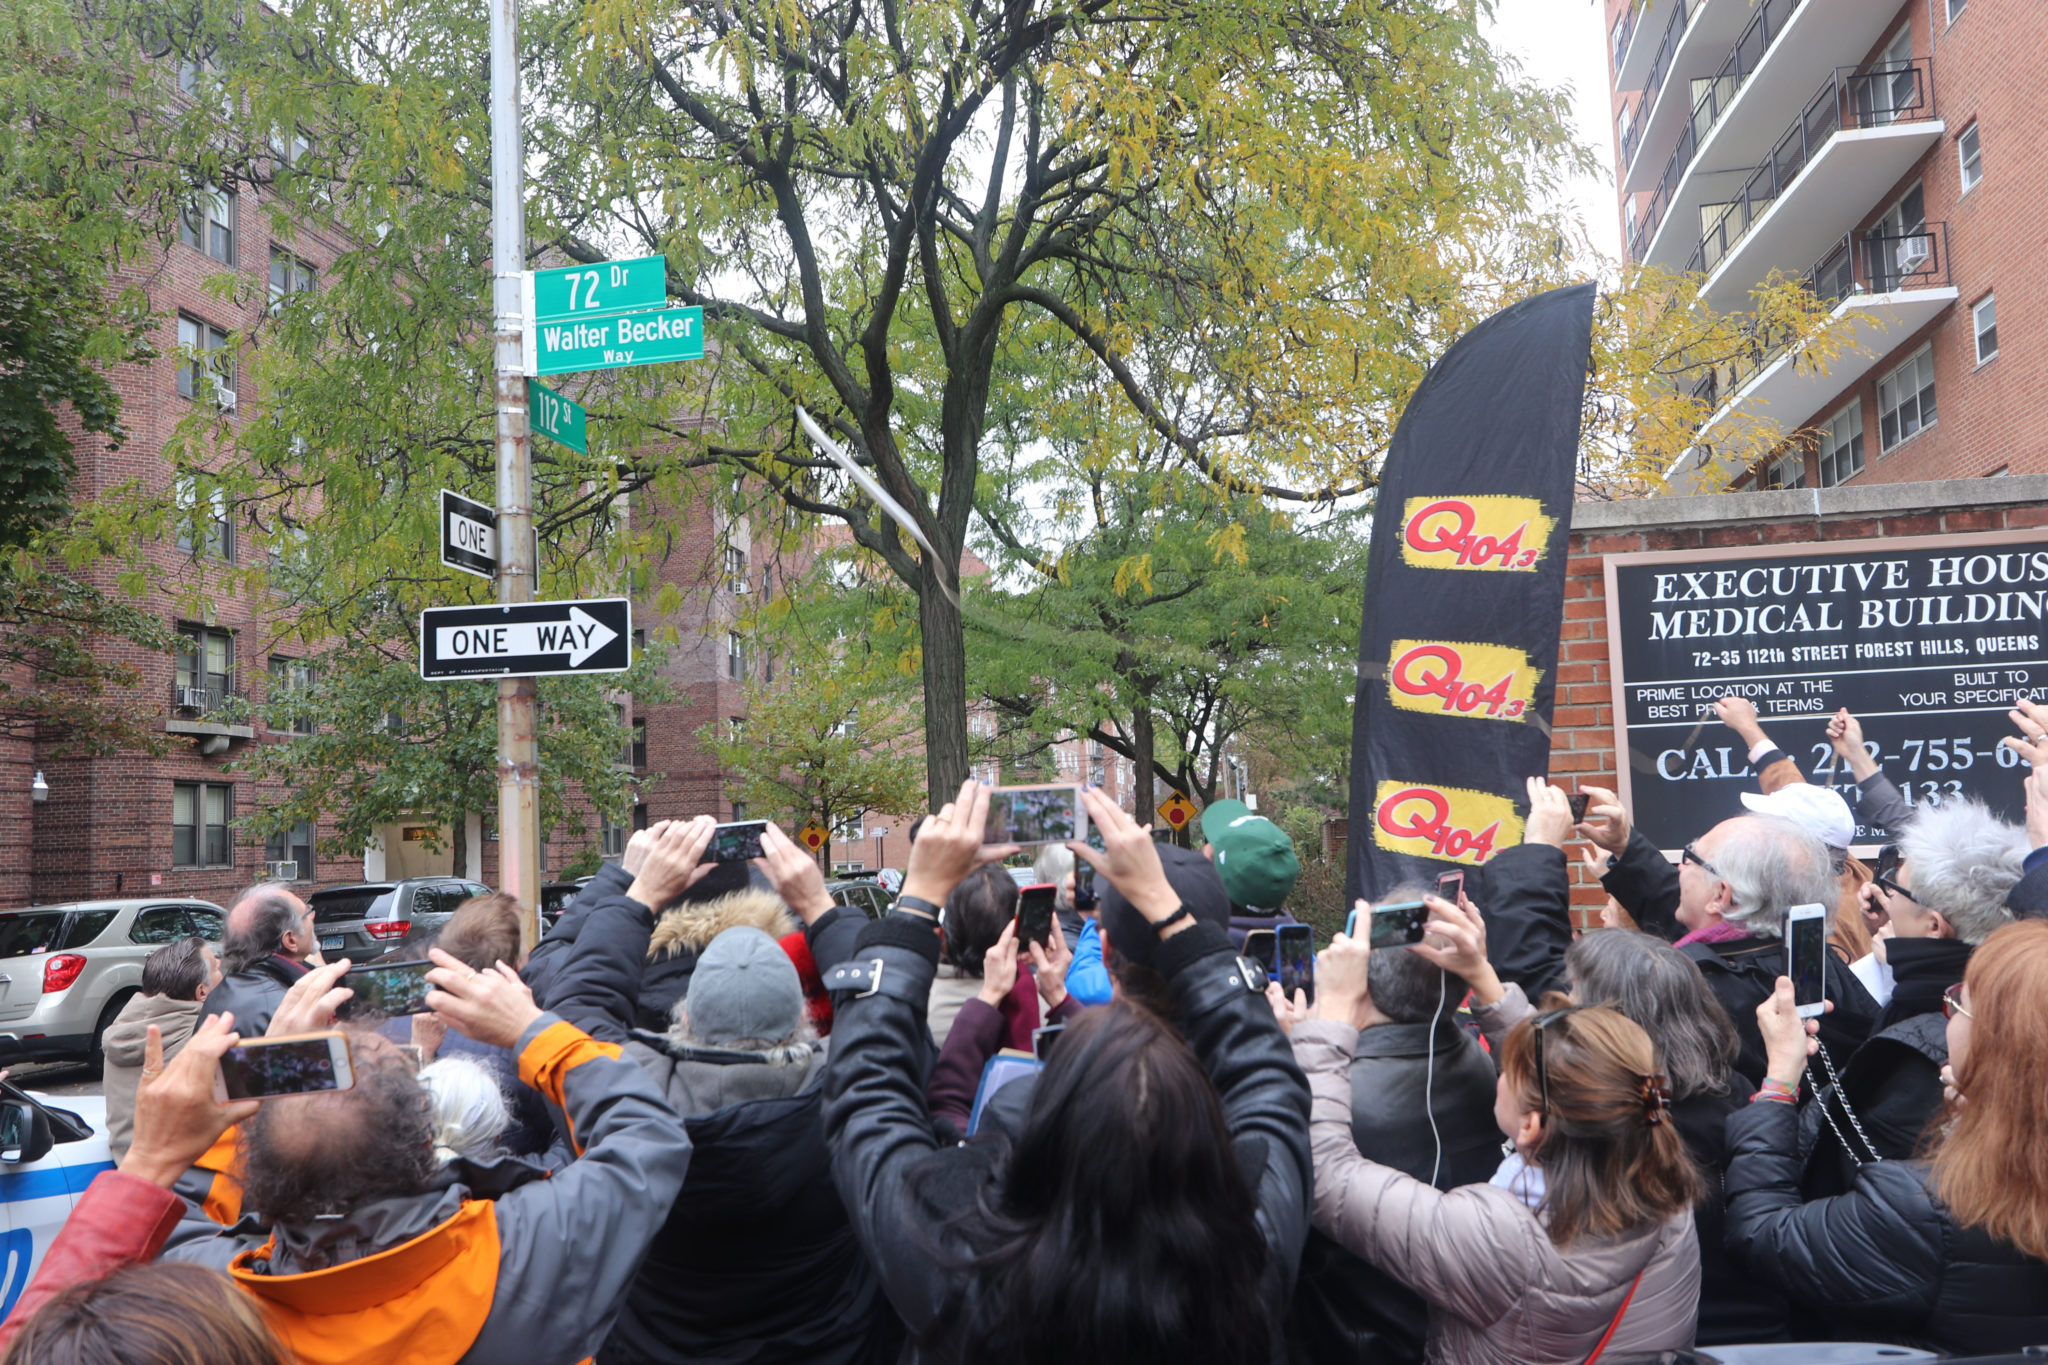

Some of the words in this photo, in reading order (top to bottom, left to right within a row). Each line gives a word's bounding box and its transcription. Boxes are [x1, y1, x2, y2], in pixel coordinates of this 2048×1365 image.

[565, 271, 600, 310] 72
[611, 266, 629, 288] Dr
[544, 323, 609, 352] Walter
[618, 315, 694, 344] Becker
[603, 350, 634, 364] Way
[538, 392, 559, 434] 112
[563, 402, 572, 425] St
[459, 520, 486, 553] ONE
[1652, 560, 1909, 602] EXECUTIVE
[1648, 602, 1843, 640] MEDICAL
[1858, 590, 2048, 629] BUILDIN
[452, 628, 508, 655] ONE
[537, 624, 596, 651] WAY
[1692, 650, 1740, 667] 72-35
[1747, 648, 1785, 664] 112th
[1792, 644, 1849, 662] STREET
[1855, 641, 1913, 658] FOREST
[1920, 639, 1969, 655] HILLS,
[1976, 635, 2039, 655] QUEENS
[1637, 687, 1685, 701] PRIME
[1692, 683, 1769, 699] LOCATION
[1776, 682, 1794, 694] AT
[1800, 680, 1833, 693] THE
[1954, 671, 1998, 686] BUILT
[2005, 670, 2029, 684] TO
[1648, 704, 1689, 718] BEST
[1767, 698, 1824, 712] TERMS
[1899, 692, 1947, 706] YOUR
